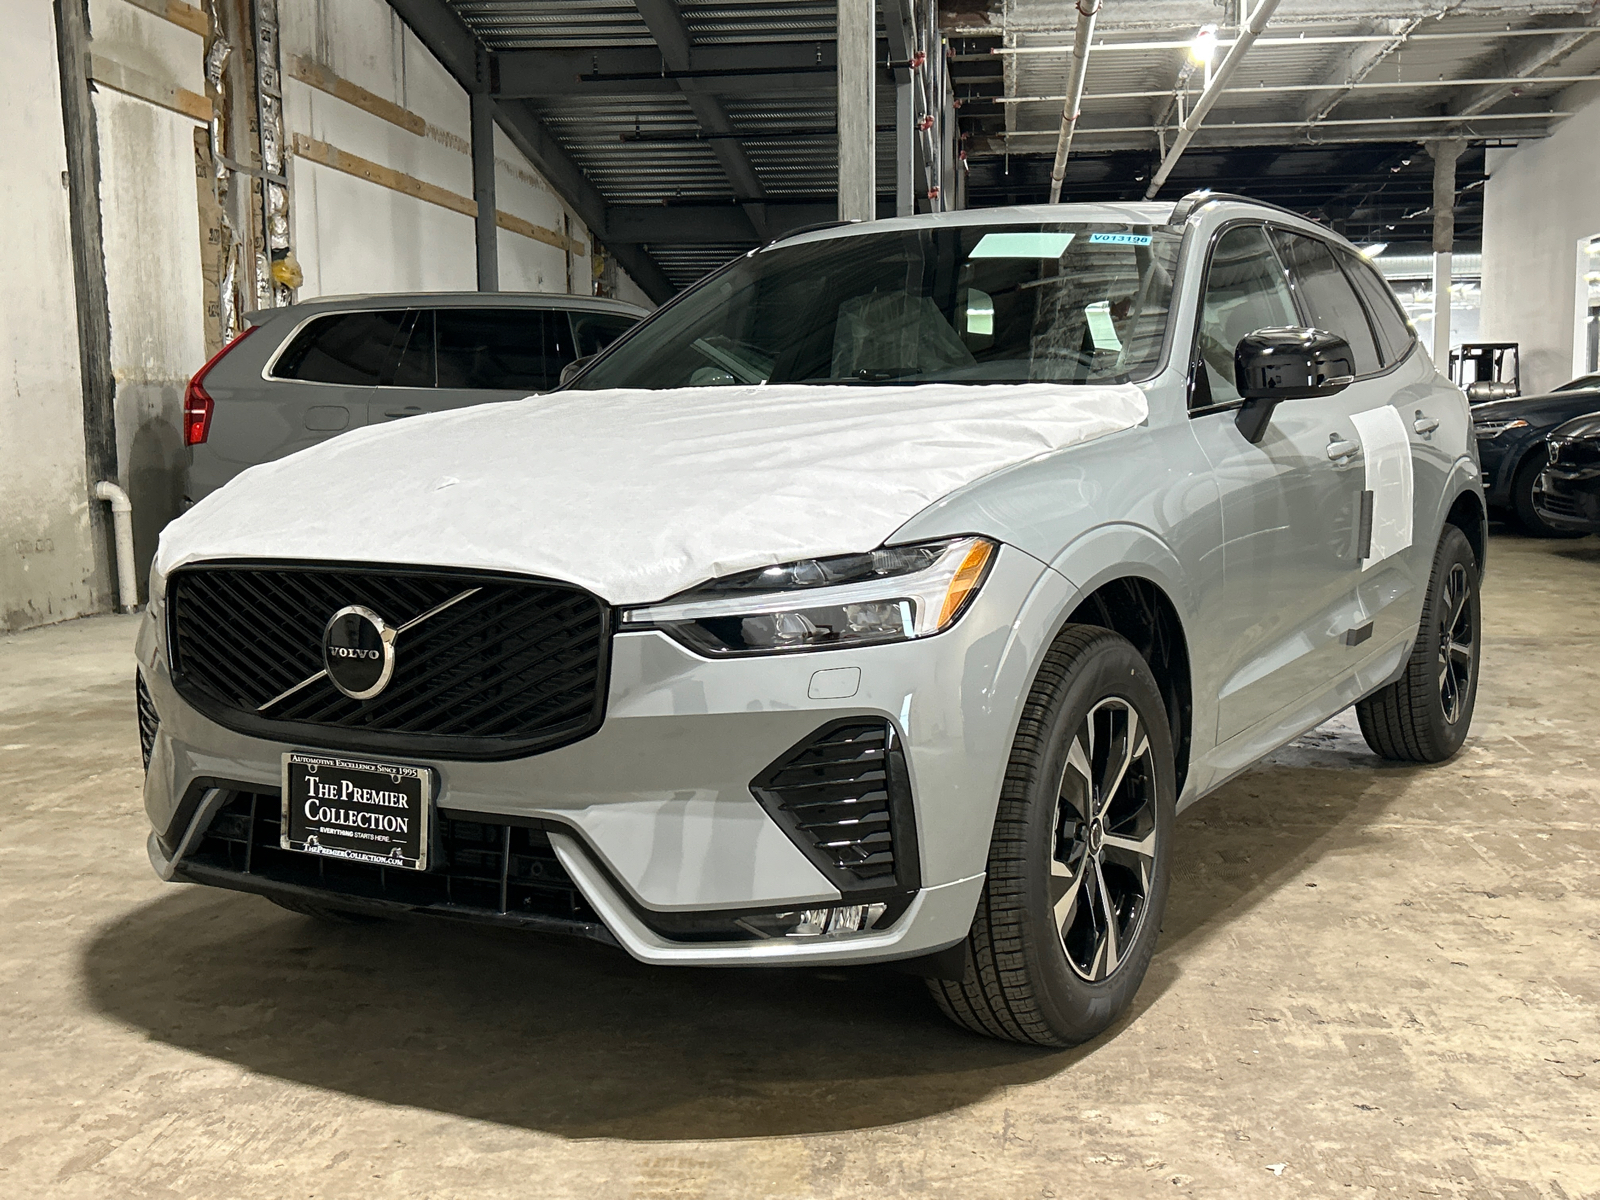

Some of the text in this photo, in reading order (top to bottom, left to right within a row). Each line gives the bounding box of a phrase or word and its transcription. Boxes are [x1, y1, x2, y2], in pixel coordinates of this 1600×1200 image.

[1094, 234, 1148, 243] V013198
[329, 646, 380, 660] VOLVO
[398, 768, 417, 777] 1995
[305, 775, 409, 808] THE PREMIER
[304, 799, 409, 833] COLLECTION
[319, 826, 354, 837] EVERYTHING
[354, 831, 375, 841] STARTS
